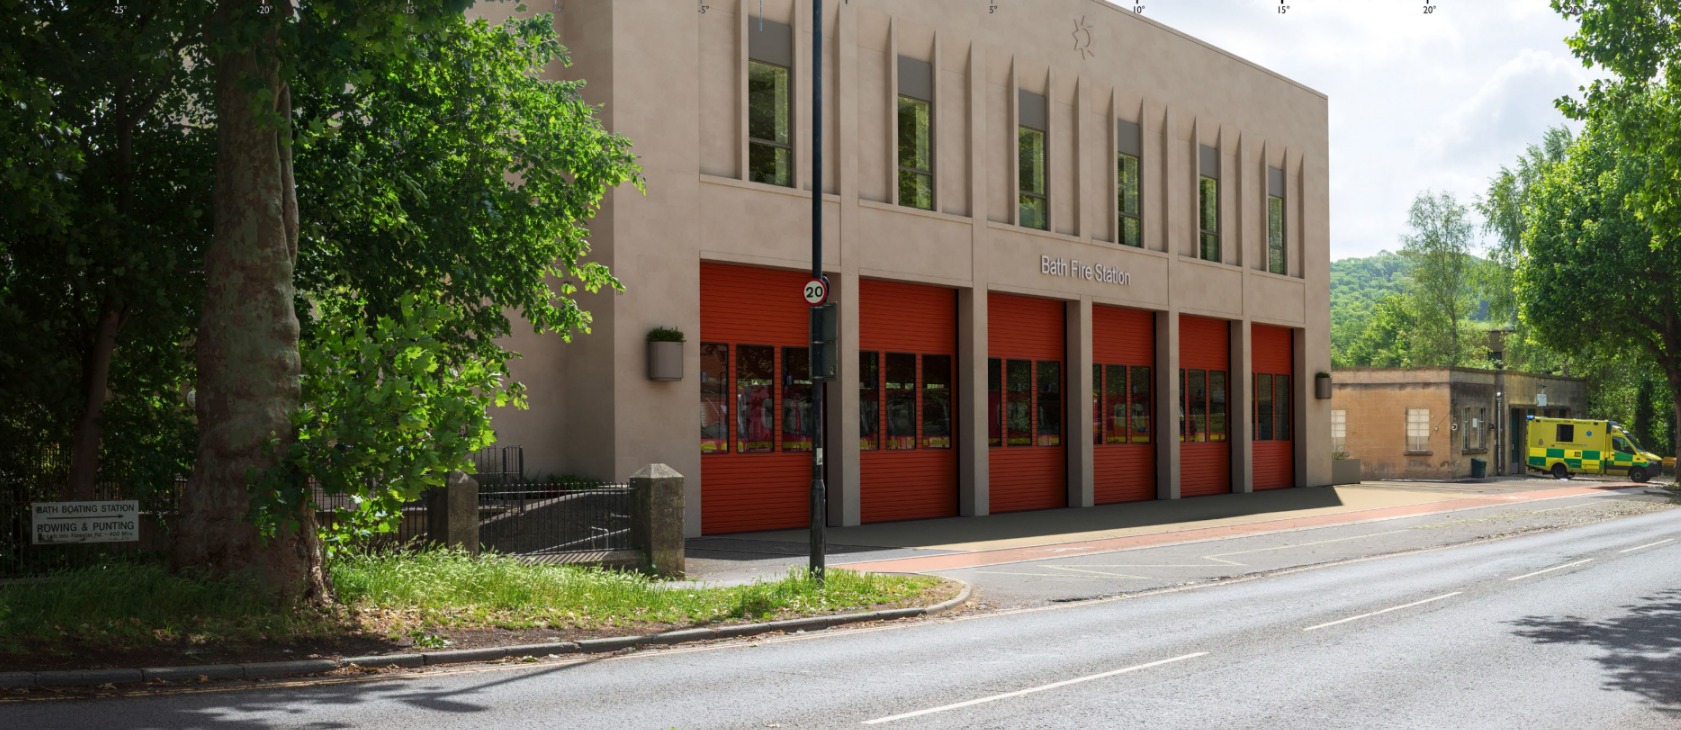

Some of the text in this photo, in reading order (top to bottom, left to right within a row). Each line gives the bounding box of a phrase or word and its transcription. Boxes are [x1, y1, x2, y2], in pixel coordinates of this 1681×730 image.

[1040, 255, 1130, 286] Bath Fire Station
[806, 286, 823, 298] 20
[36, 506, 58, 514] BATH
[37, 521, 134, 532] ROWING & PUNTING
